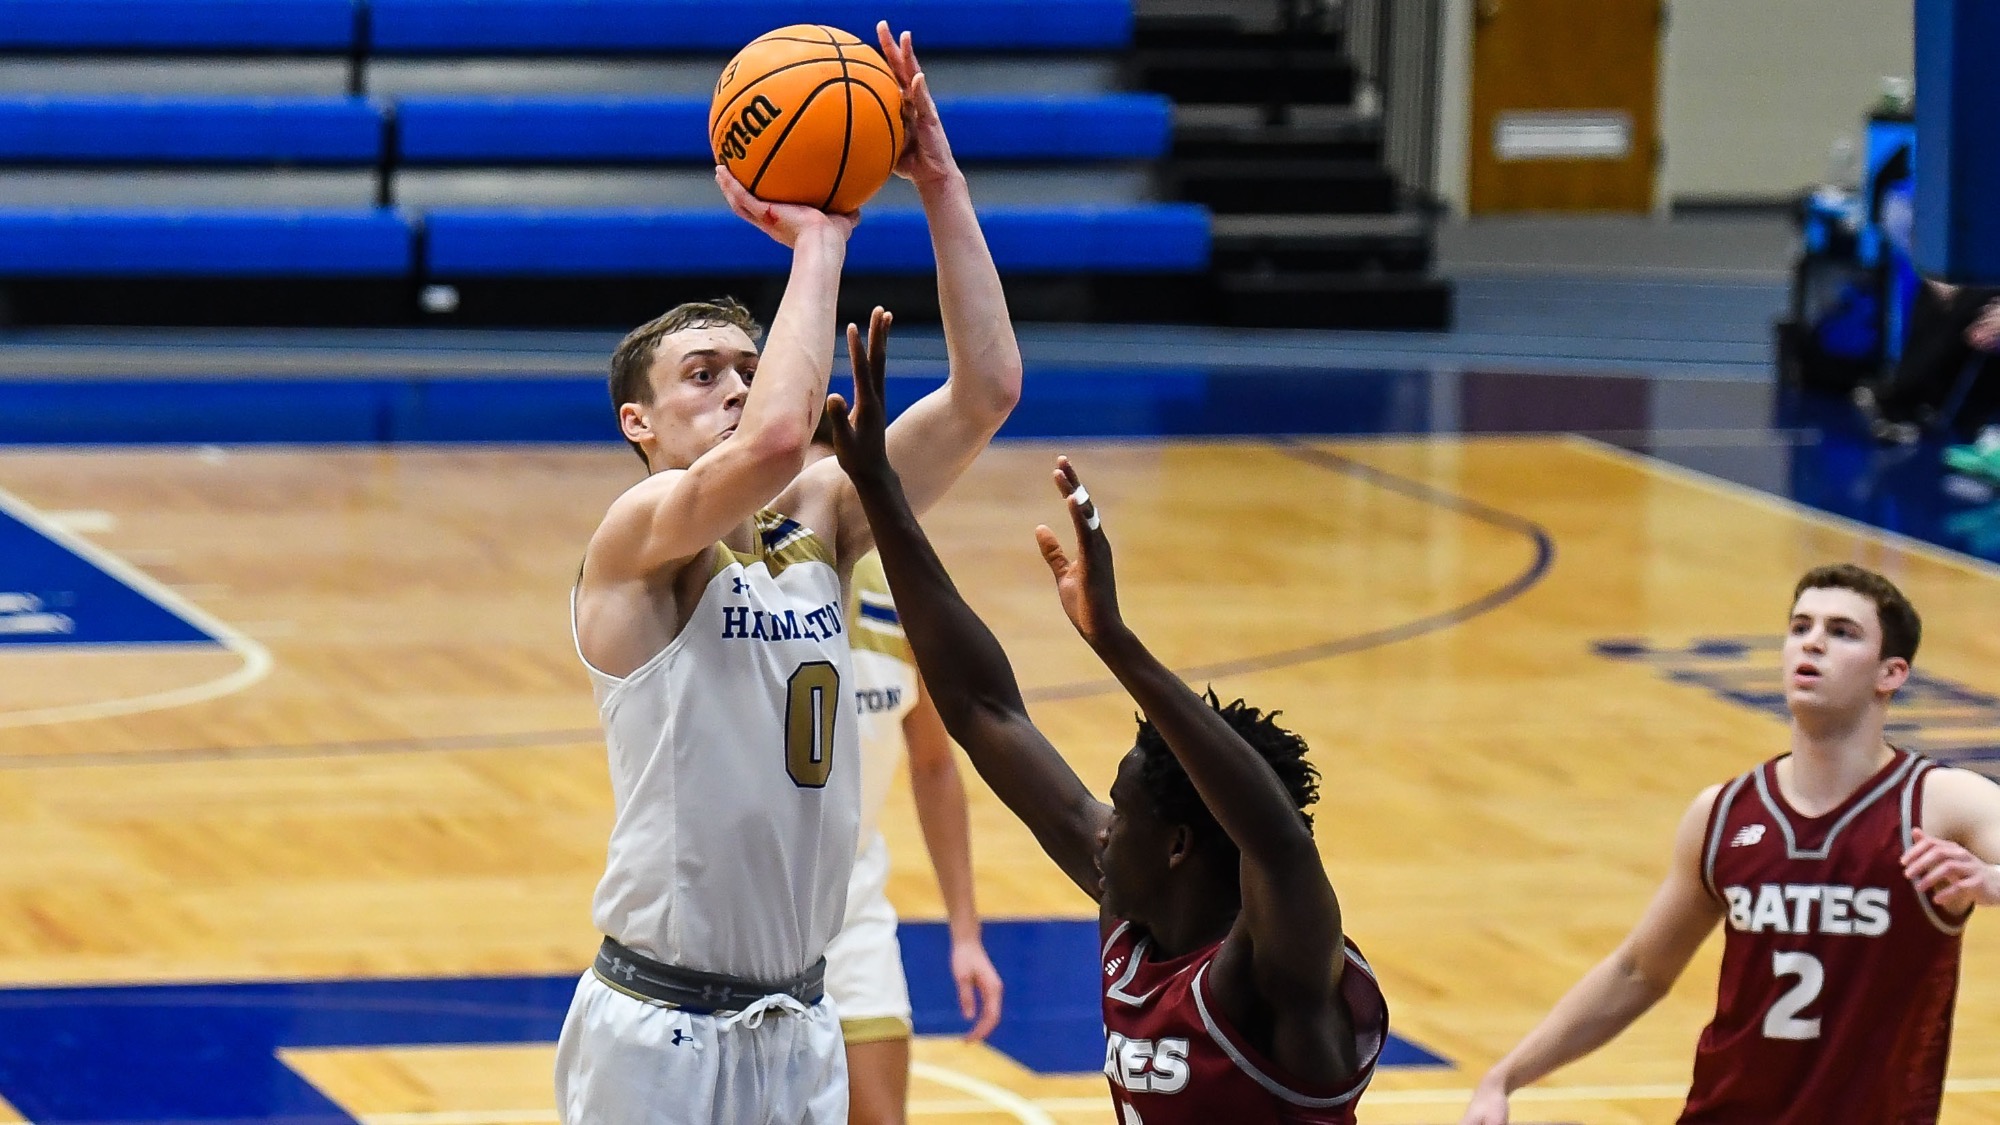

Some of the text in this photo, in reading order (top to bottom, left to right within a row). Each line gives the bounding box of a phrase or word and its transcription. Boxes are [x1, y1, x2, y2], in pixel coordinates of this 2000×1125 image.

[784, 660, 841, 789] 0
[1723, 883, 1892, 938] BATES
[1762, 949, 1825, 1040] 2
